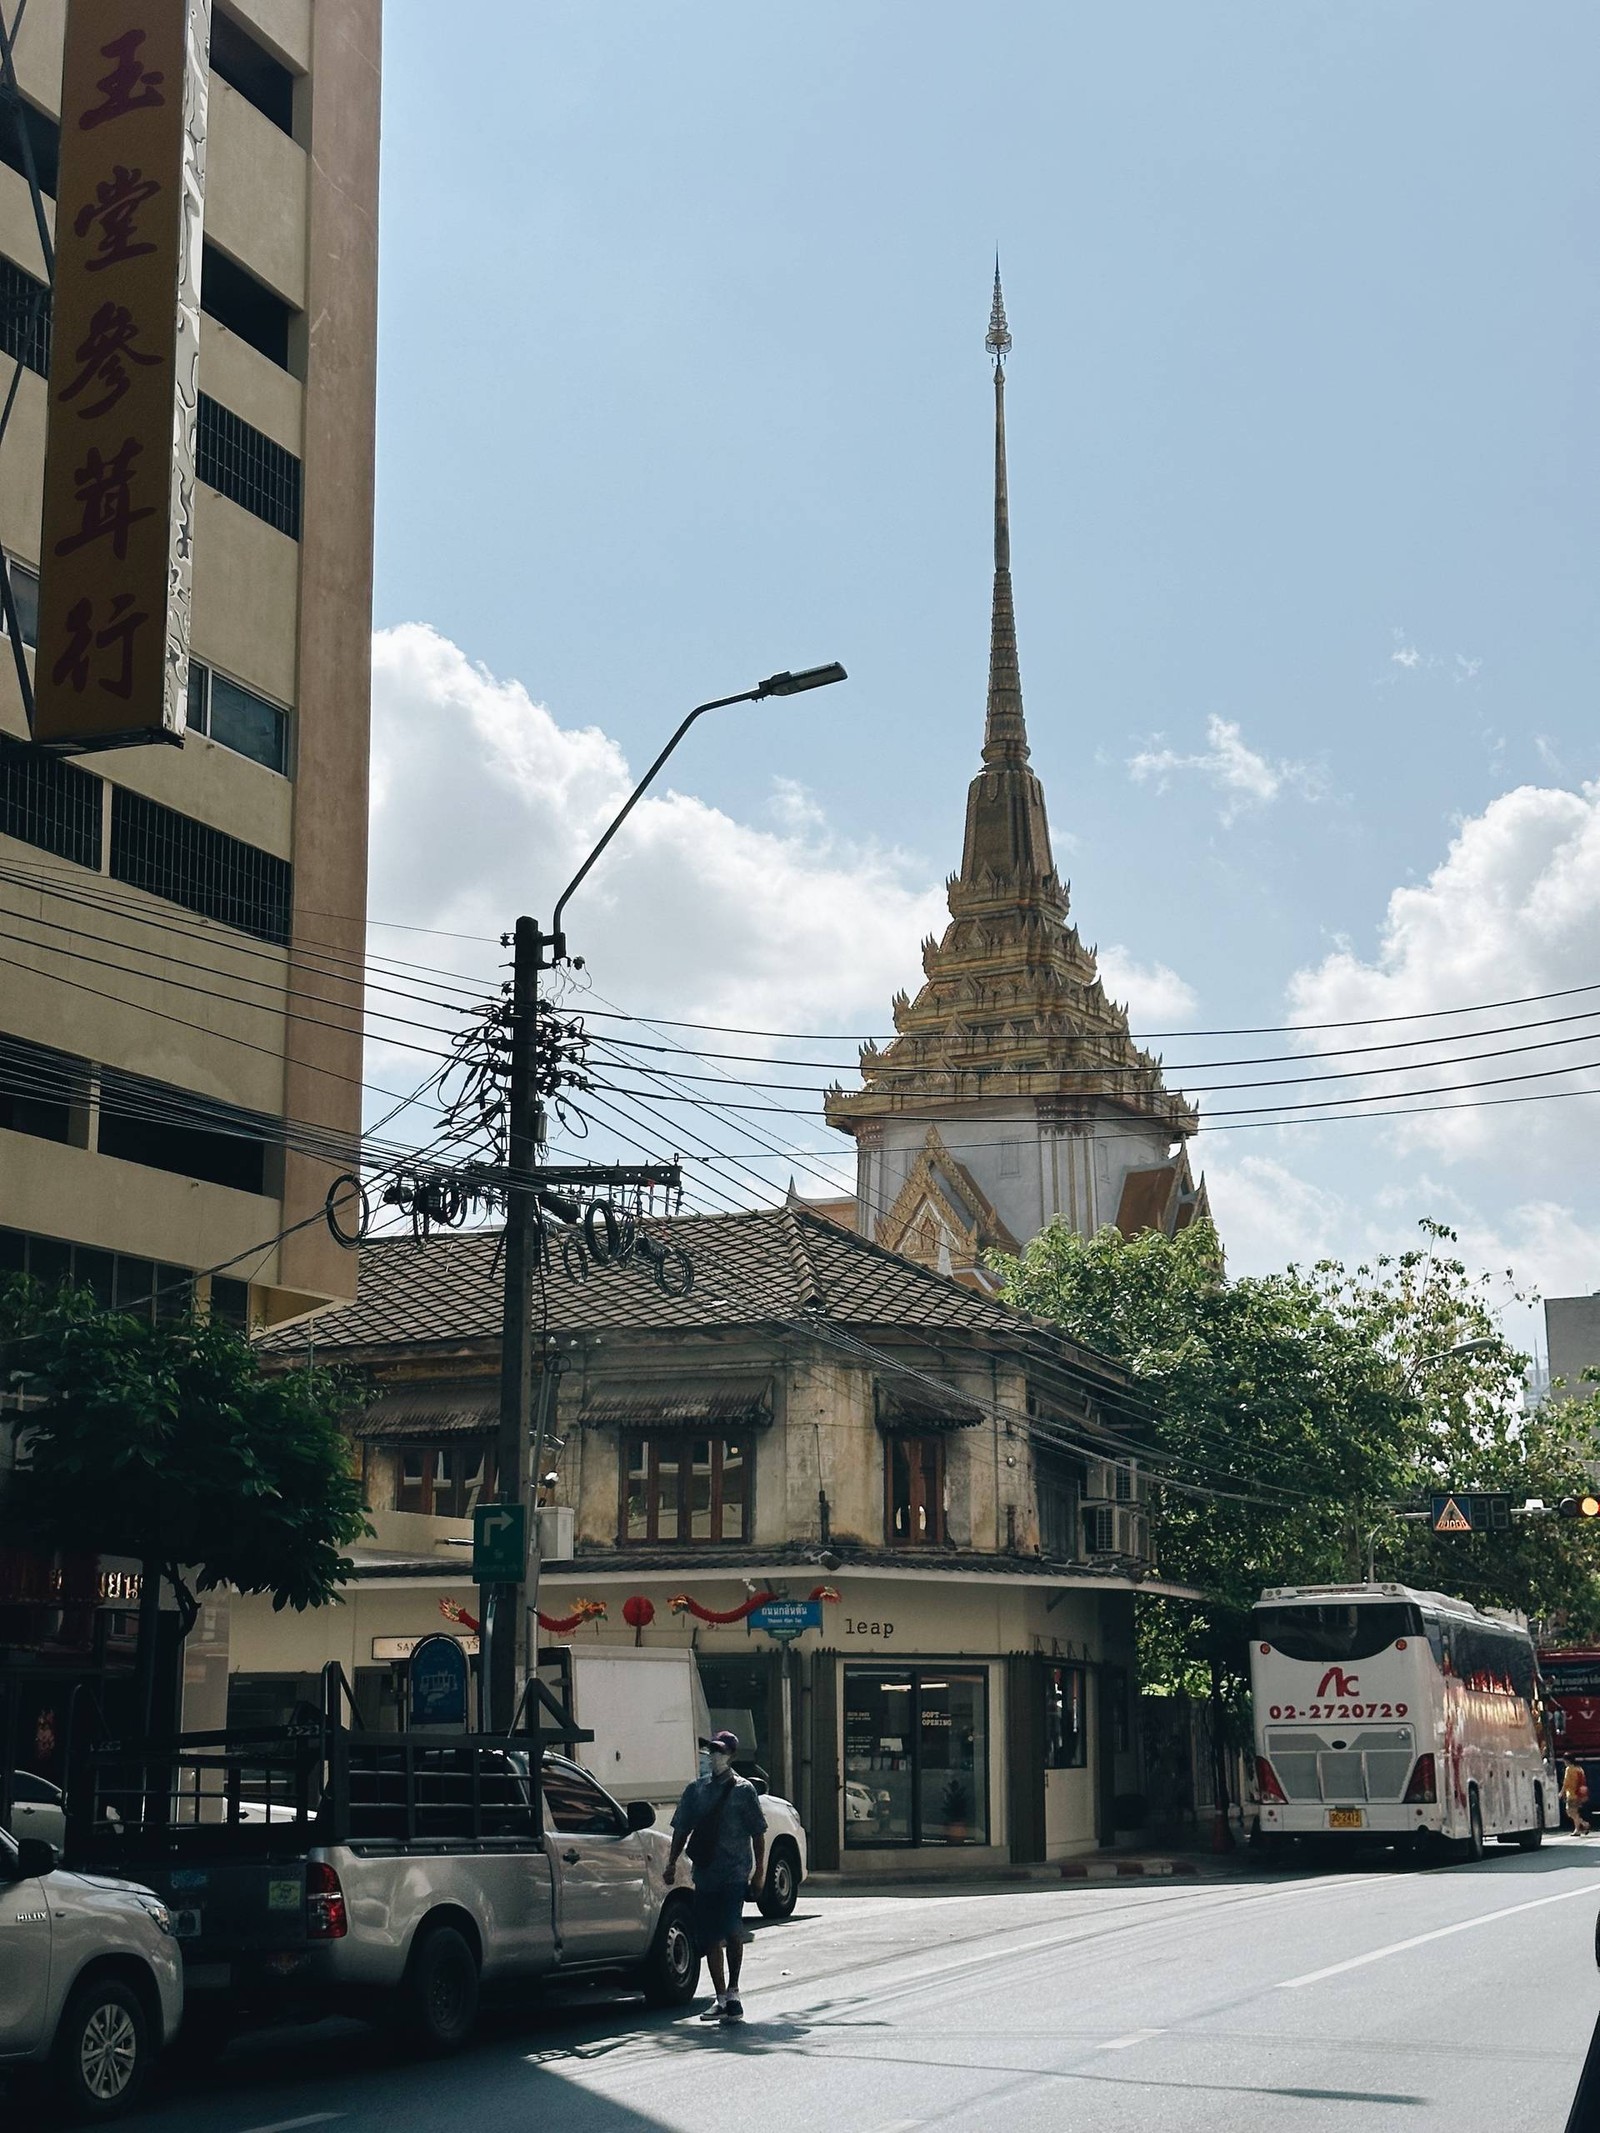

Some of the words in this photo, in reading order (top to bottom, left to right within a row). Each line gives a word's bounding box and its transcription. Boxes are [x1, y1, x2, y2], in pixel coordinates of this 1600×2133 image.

[845, 1618, 894, 1639] leap
[1269, 1703, 1408, 1720] 02-2720729
[921, 1719, 952, 1727] OPENING
[16, 1911, 47, 1922] HILUX
